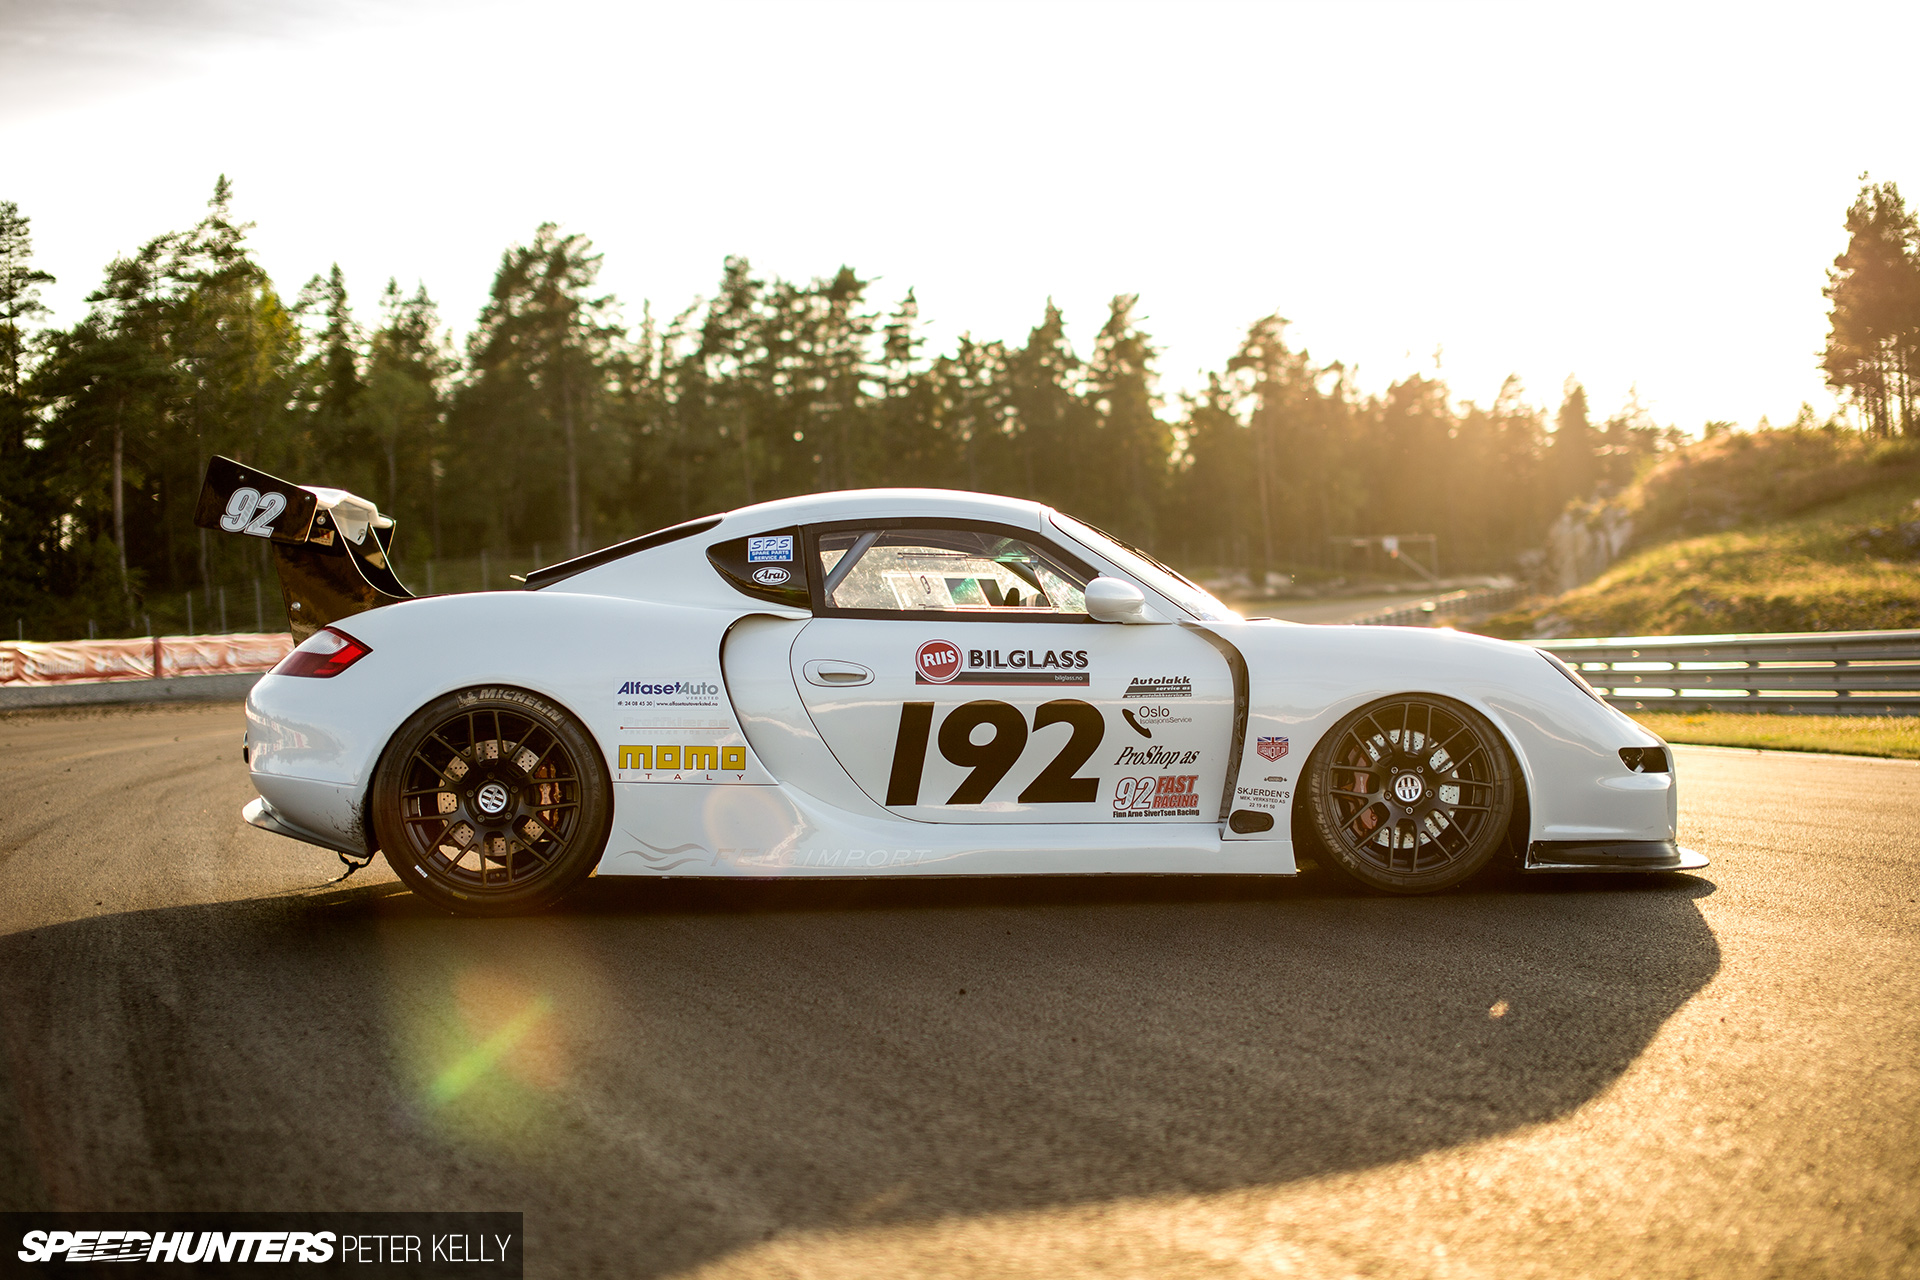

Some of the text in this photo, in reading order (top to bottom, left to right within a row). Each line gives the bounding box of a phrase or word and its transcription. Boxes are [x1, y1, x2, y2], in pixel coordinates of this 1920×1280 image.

[220, 487, 287, 538] 92
[752, 539, 790, 550] SPS
[756, 569, 785, 580] Arai
[922, 650, 956, 668] RIIS
[968, 650, 1089, 670] BILGLASS
[1054, 674, 1083, 682] bilglass.no
[1130, 676, 1191, 685] Autolakk
[479, 687, 565, 722] MICHELIN
[1139, 705, 1170, 718] Oslo
[885, 698, 1106, 806] 192
[1113, 745, 1201, 769] ProShop as
[618, 773, 745, 781] ITALY
[1113, 775, 1200, 811] 92 FAST
[1237, 786, 1290, 799] SKJERDEN'S
[1152, 793, 1200, 810] RACING
[1113, 810, 1127, 818] Finn
[1177, 808, 1200, 816] Racing
